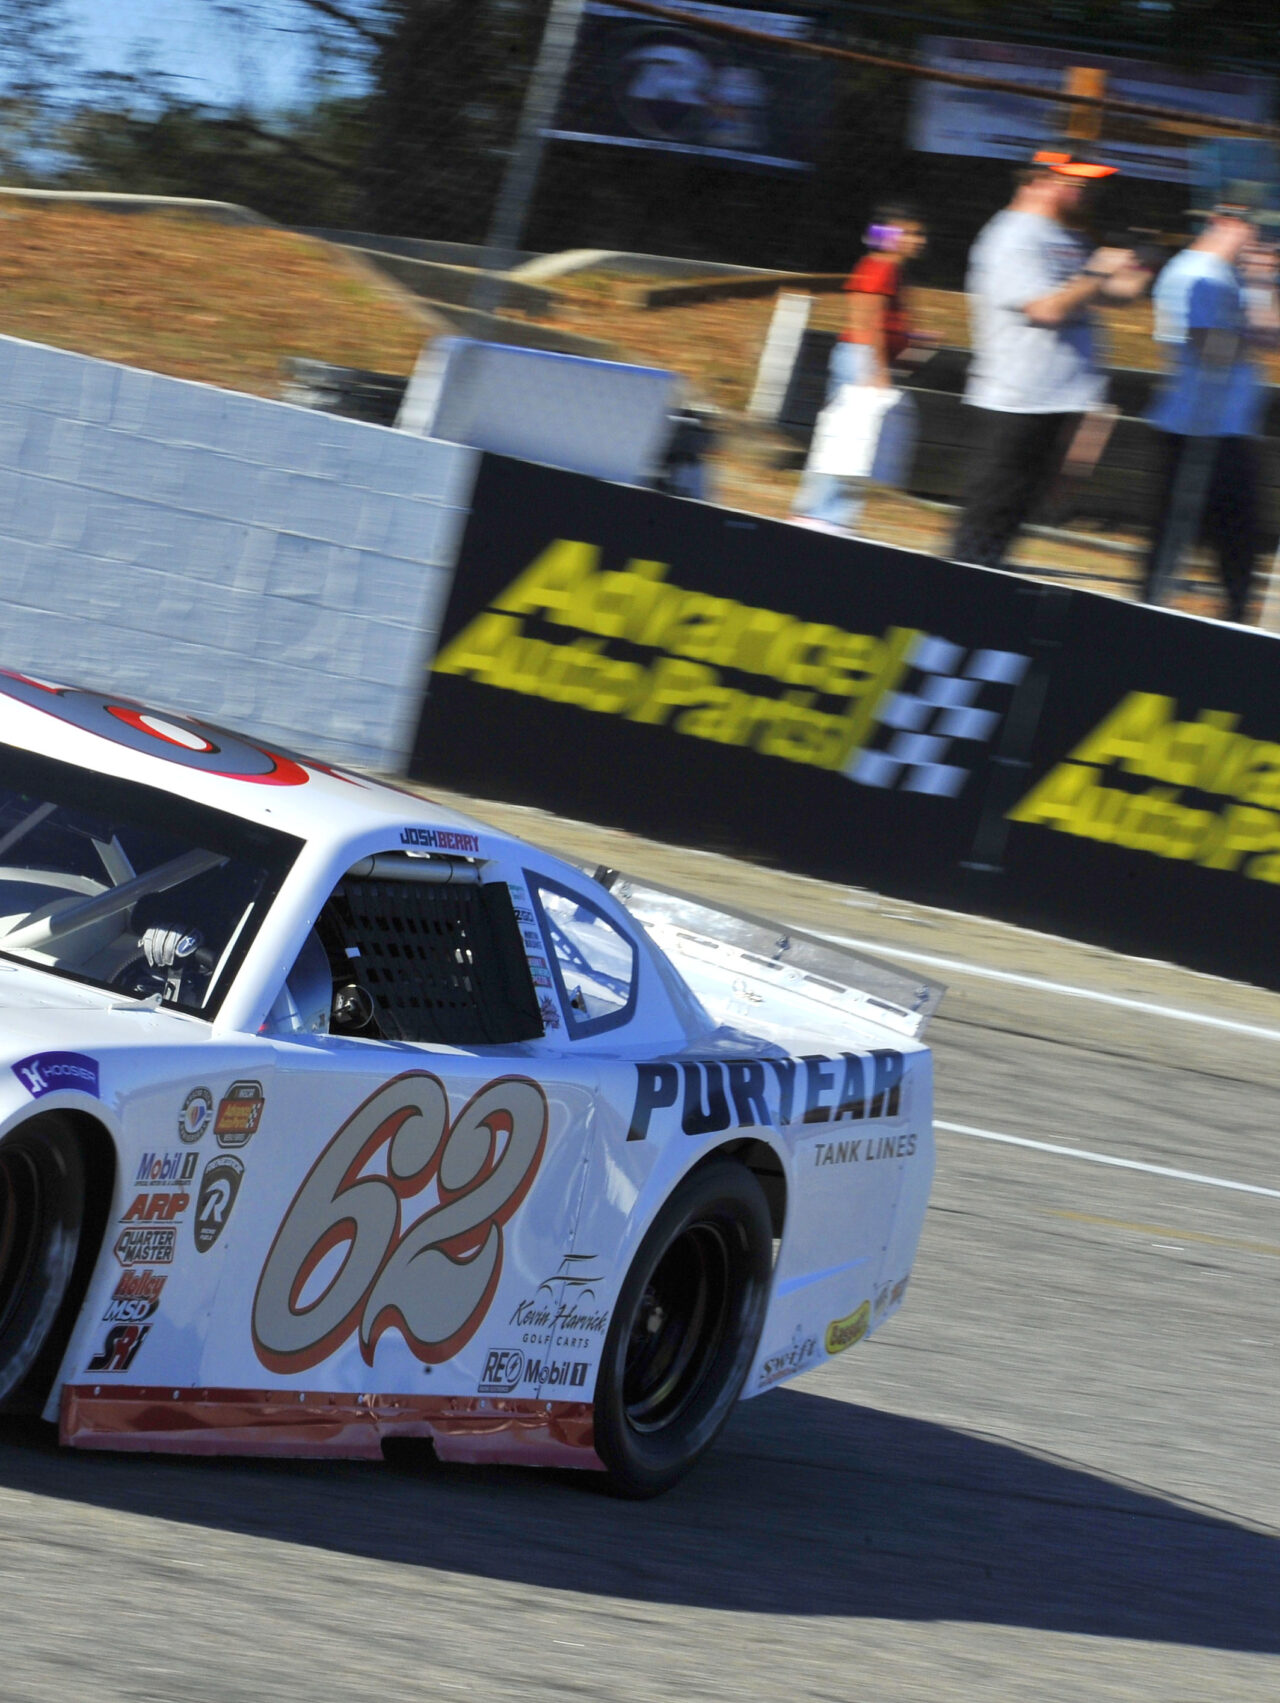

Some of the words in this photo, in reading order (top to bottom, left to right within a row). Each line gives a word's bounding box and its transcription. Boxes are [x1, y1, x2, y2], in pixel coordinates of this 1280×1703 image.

[494, 539, 886, 696] Advance
[432, 610, 652, 714] Auto
[628, 655, 854, 768] Parts
[1068, 690, 1280, 810] Adva
[1004, 762, 1214, 861] Auto
[1194, 803, 1280, 885] Pa
[625, 1047, 905, 1143] PURYEAR
[814, 1139, 859, 1167] TANK
[865, 1133, 919, 1160] LINES
[136, 1152, 183, 1181] Mobil
[181, 1152, 198, 1179] 1
[122, 1193, 190, 1221] ARP
[251, 1069, 548, 1375] 62
[118, 1230, 173, 1250] QUARTER
[124, 1245, 172, 1262] MASTER
[113, 1269, 168, 1302] Holley
[103, 1300, 156, 1321] MSD
[509, 1299, 550, 1327] Kevin
[522, 1333, 550, 1344] GOLF
[556, 1336, 590, 1349] CARTS
[523, 1359, 570, 1386] Mobil
[572, 1363, 587, 1386] 1
